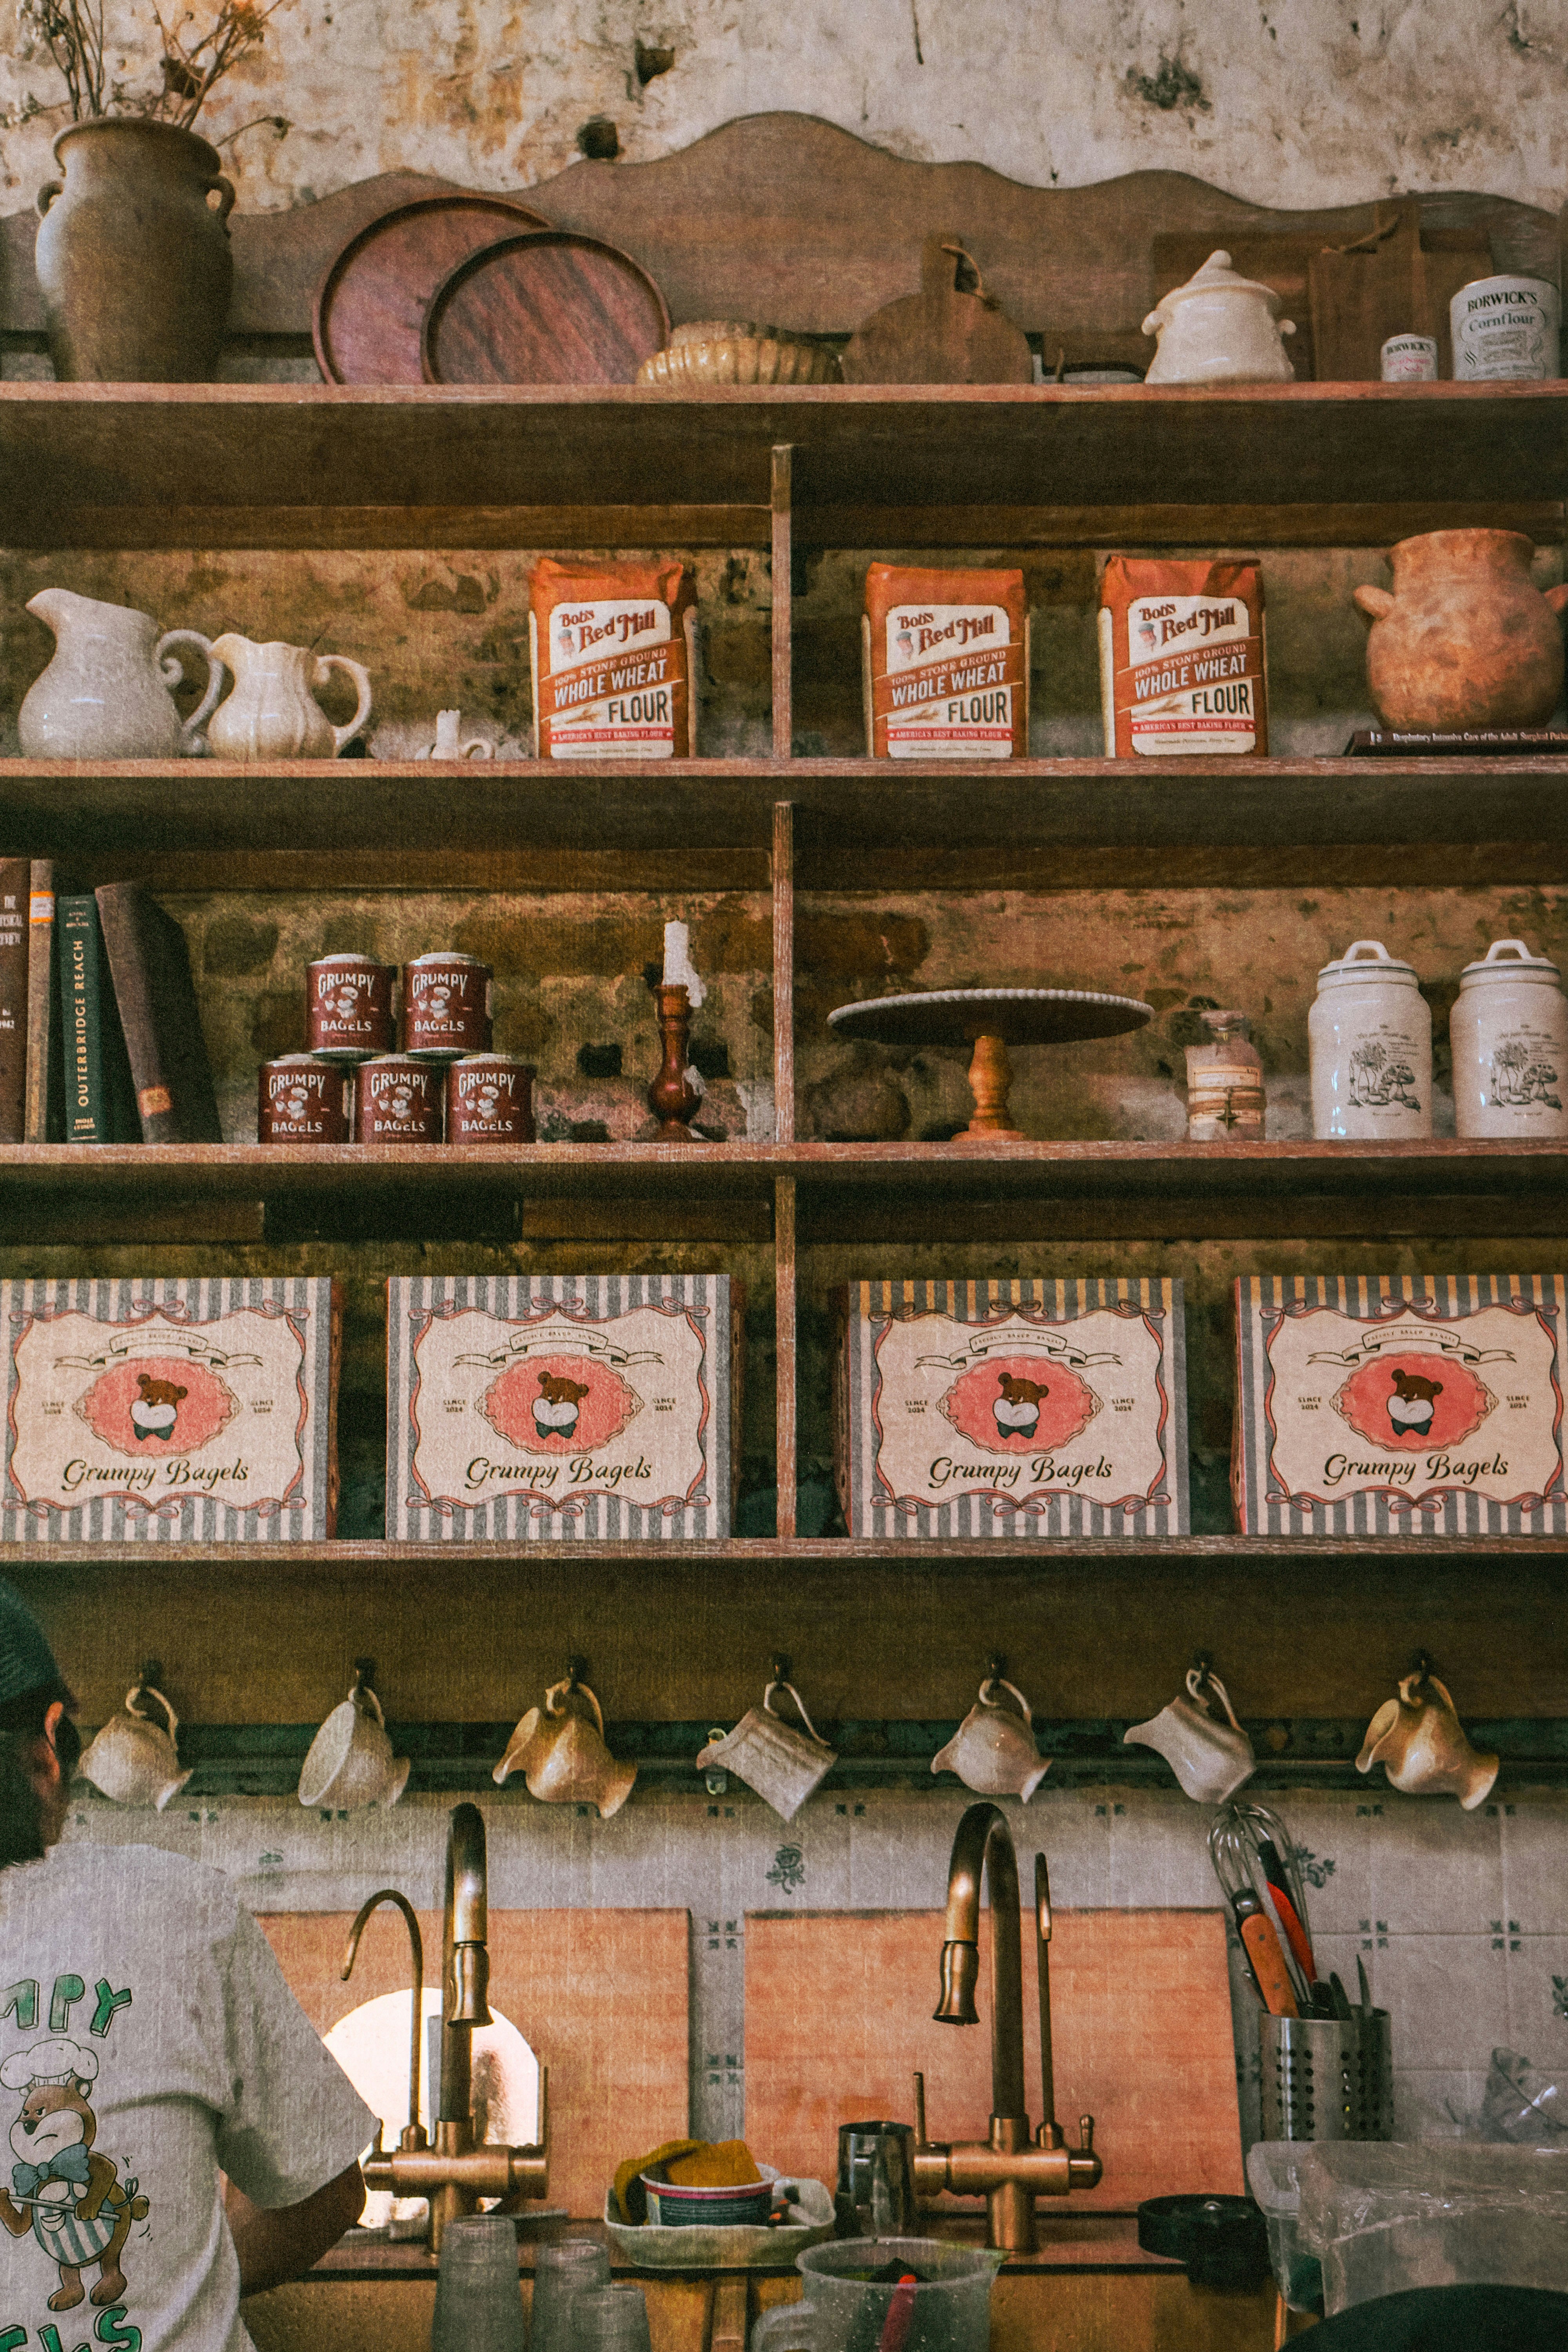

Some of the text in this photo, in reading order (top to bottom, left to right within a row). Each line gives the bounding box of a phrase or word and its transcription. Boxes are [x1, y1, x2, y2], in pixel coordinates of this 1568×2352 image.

[1468, 291, 1537, 313] BORWICK'S
[1469, 313, 1535, 332] Cornflour
[559, 609, 595, 627] Bob's
[897, 613, 934, 629] Bob's
[1139, 603, 1176, 621] Bob's
[1160, 605, 1236, 646] Red Mill
[579, 608, 656, 652] Red Mill
[918, 613, 994, 655] Red Mill
[555, 647, 666, 686] 100% STONE GROUND
[892, 650, 1006, 686] 100% STONE GROUND
[1135, 643, 1246, 679] 100% STONE GROUND
[1135, 654, 1247, 699] WHOLE WHEAT
[554, 659, 667, 707] WHOLE WHEAT
[892, 661, 1006, 706] WHOLE WHEAT
[1192, 683, 1250, 714] FLOUR
[608, 690, 669, 723] FLOUR
[948, 691, 1007, 722] FLOUR
[73, 940, 85, 991] REACH
[318, 973, 375, 998] GRUMPY
[412, 973, 468, 998] GRUMPY
[321, 1020, 372, 1032] BAGELS
[414, 1020, 465, 1032] BAGELS
[75, 998, 89, 1107] OUTERBRIDGE
[269, 1074, 326, 1100] GRUMPY
[371, 1073, 428, 1098] GRUMPY
[458, 1073, 516, 1098] GRUMPY
[271, 1121, 323, 1132] BAGELS
[374, 1120, 426, 1132] BAGELS
[461, 1120, 513, 1132] BAGELS
[62, 1458, 248, 1491] Grumpy Bagels
[465, 1456, 652, 1490] Grumpy Bagels
[927, 1455, 1113, 1489] Grumpy Bagels
[1323, 1452, 1509, 1485] Grumpy Bagels
